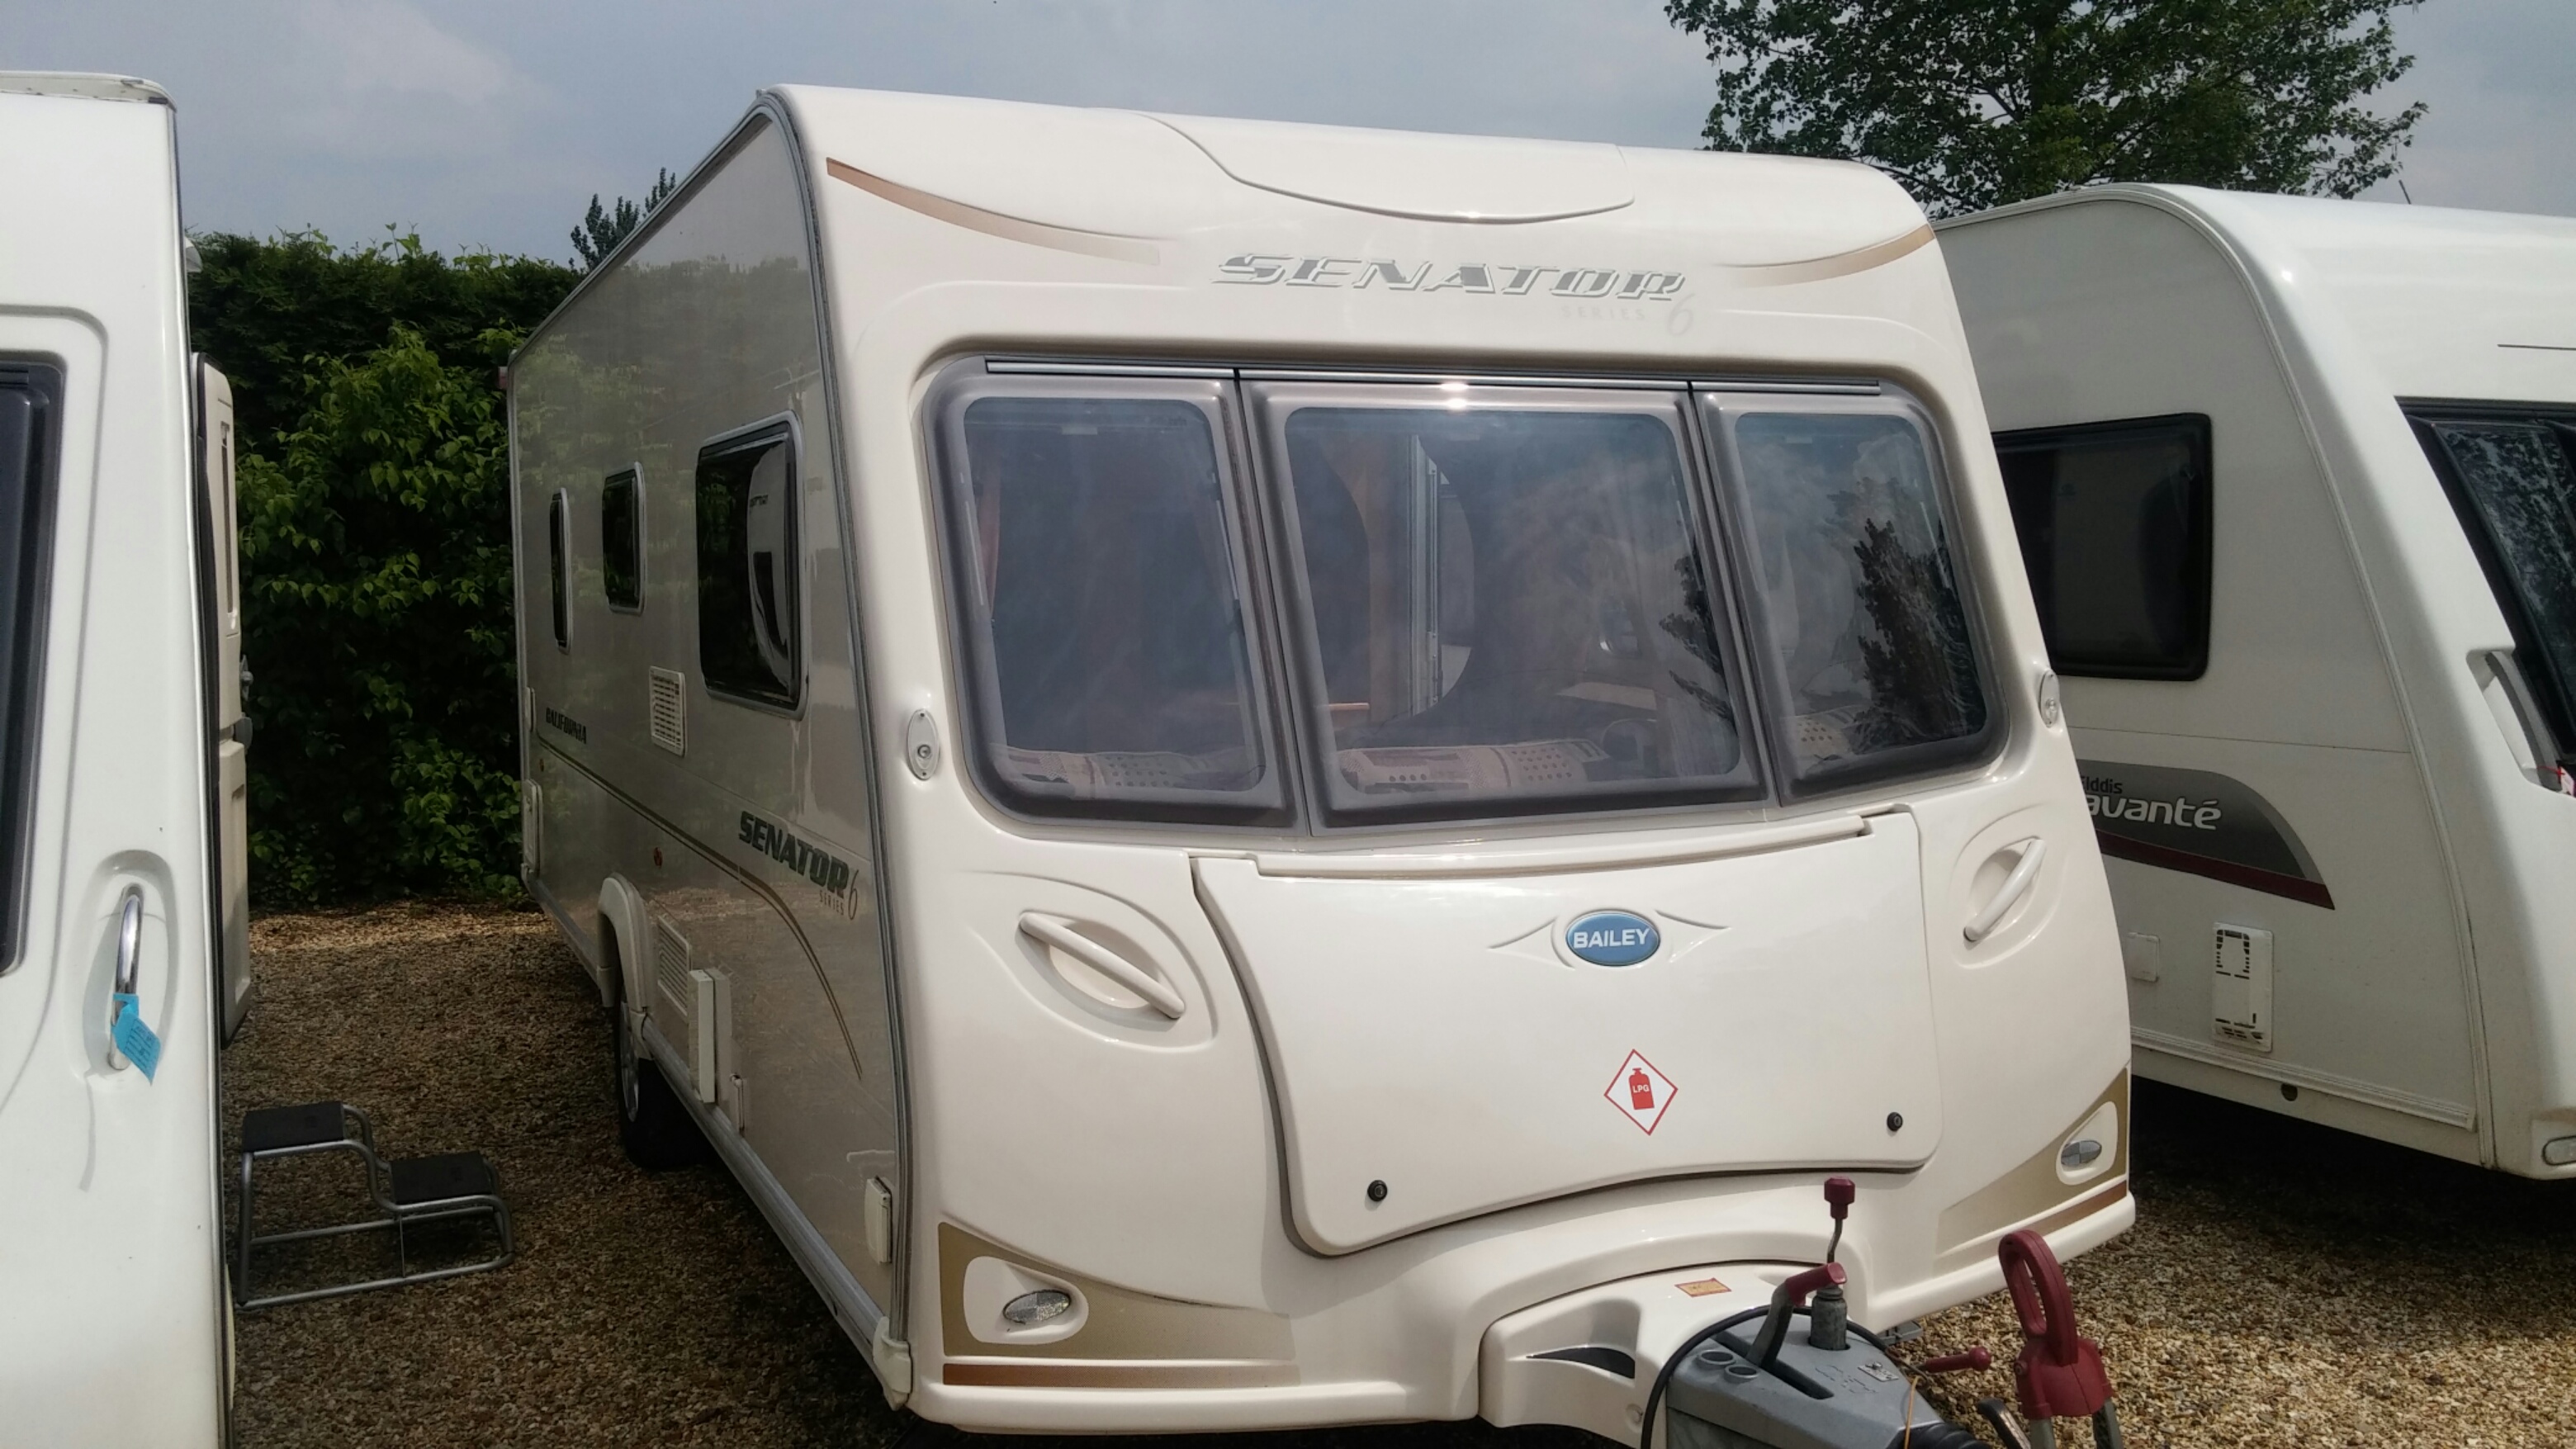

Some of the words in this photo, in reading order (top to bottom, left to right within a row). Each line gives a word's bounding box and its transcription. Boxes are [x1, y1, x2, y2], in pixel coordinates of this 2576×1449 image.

[1210, 253, 1686, 301] SENATOR
[1560, 304, 1646, 320] SERIES
[1668, 292, 1696, 337] 6
[2085, 793, 2222, 831] avanté
[738, 810, 850, 899] SENATOR
[819, 888, 844, 916] SERIES
[848, 869, 859, 921] 6
[1573, 928, 1650, 949] BAILEY
[1631, 1083, 1650, 1094] LPG
